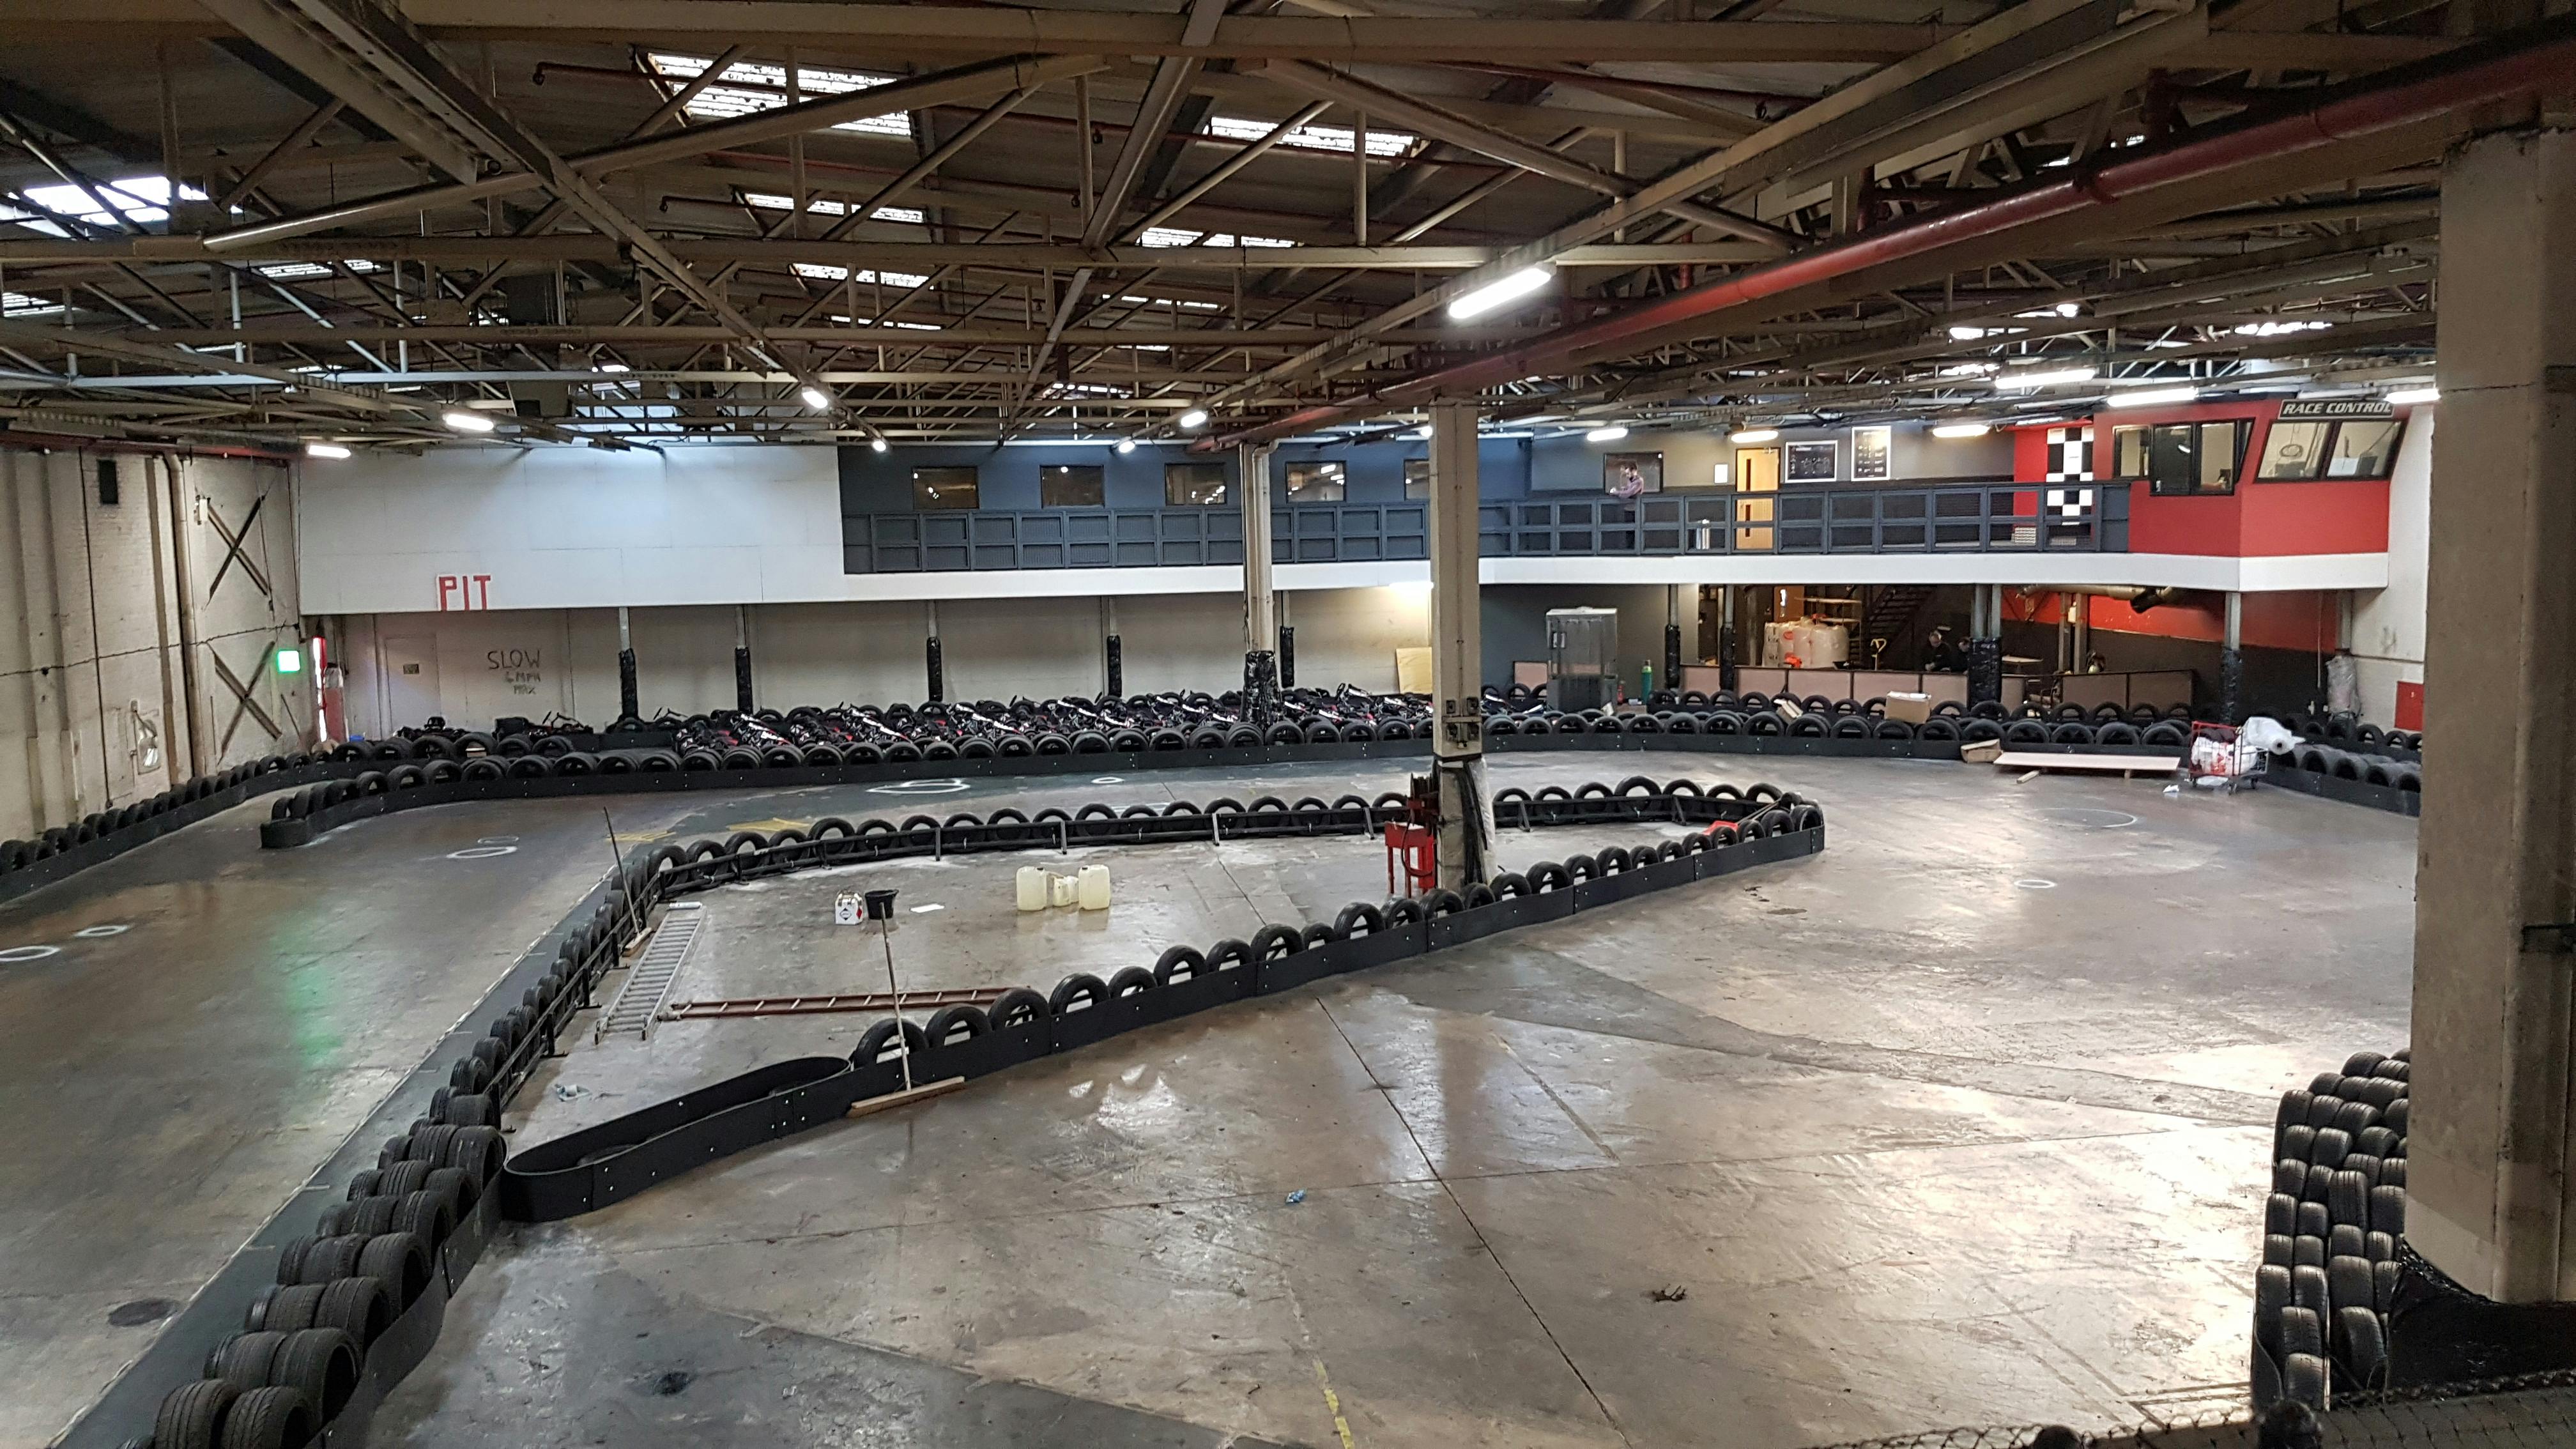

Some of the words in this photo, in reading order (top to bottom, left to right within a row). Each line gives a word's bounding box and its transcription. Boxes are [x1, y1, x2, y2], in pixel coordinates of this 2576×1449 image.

[2283, 402, 2324, 414] RACE
[2326, 402, 2391, 413] CONTROL
[438, 575, 491, 613] PIT
[487, 649, 540, 670] SLOW
